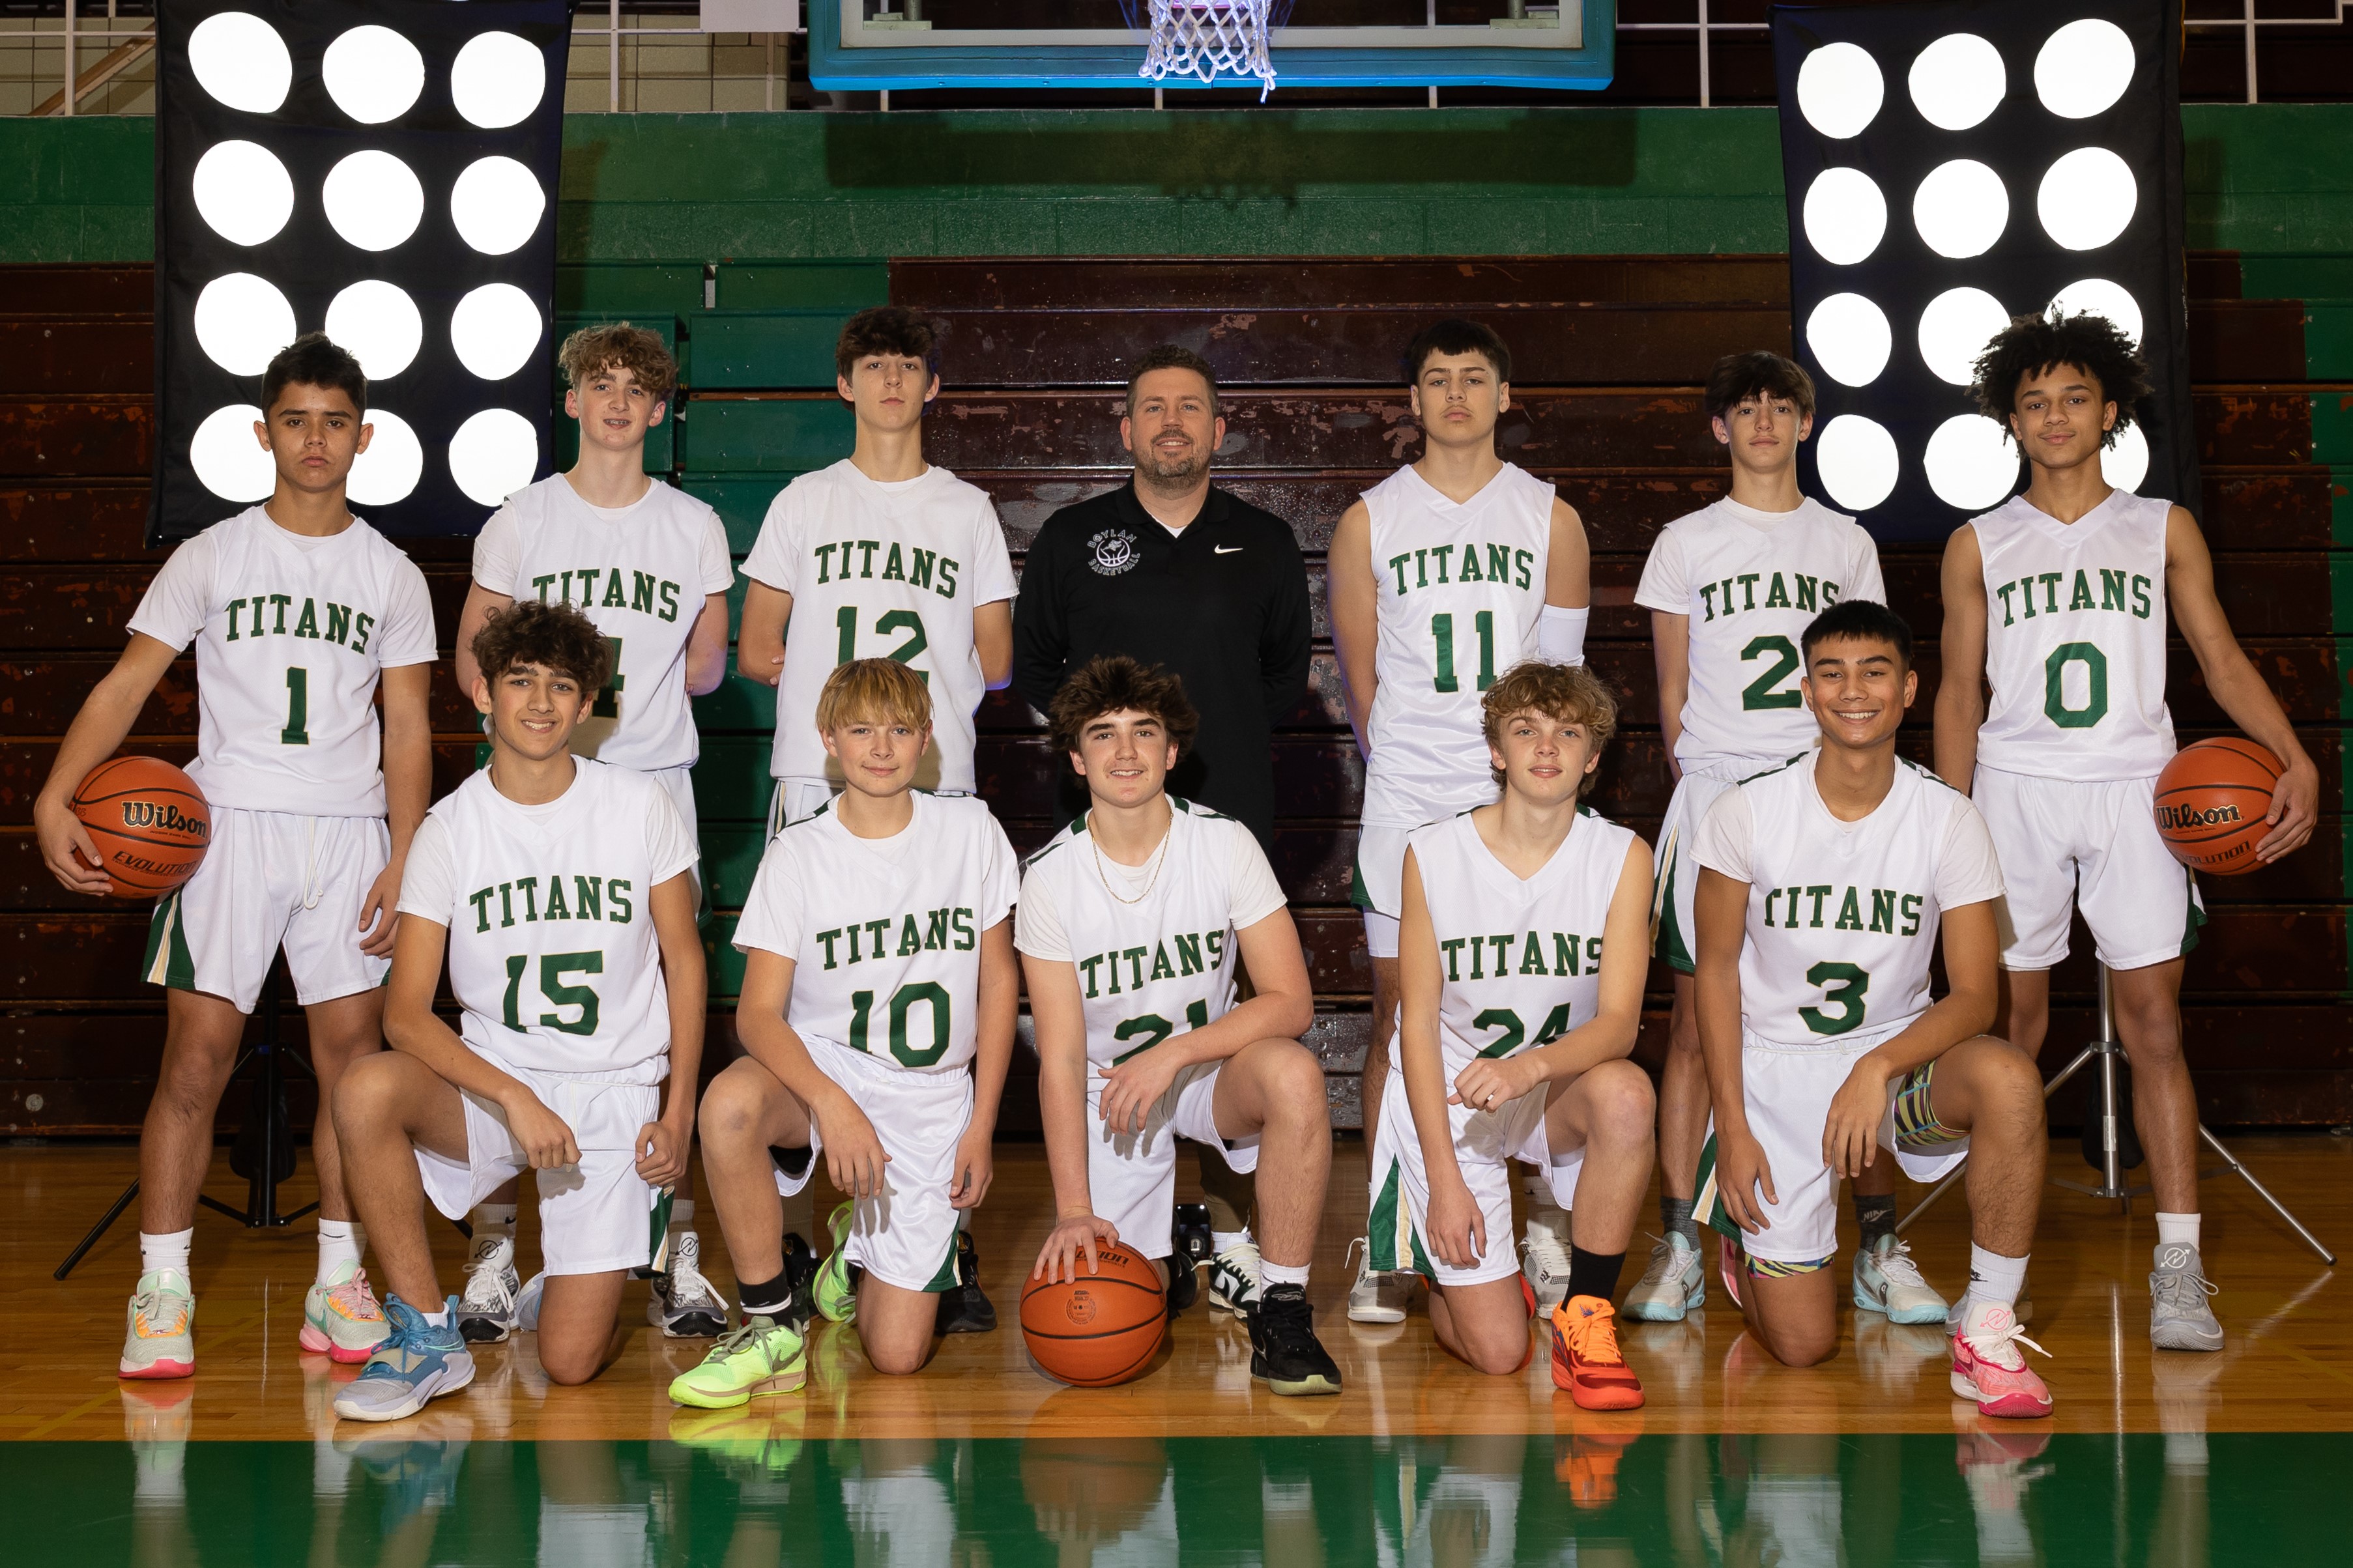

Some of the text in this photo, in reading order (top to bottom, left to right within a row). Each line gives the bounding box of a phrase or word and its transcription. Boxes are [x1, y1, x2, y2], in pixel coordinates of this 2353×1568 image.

[1087, 529, 1137, 548] BOYLAN
[1088, 553, 1140, 576] BASKETBALL
[532, 567, 680, 623] TITANS
[815, 540, 960, 600] TITANS
[1388, 542, 1535, 596] TITANS
[1699, 572, 1840, 623] TITANS
[1997, 568, 2152, 628] TITANS
[225, 593, 375, 655] TITANS
[837, 606, 930, 687] 12
[1431, 610, 1497, 693] 11
[281, 666, 310, 746] 1
[2043, 642, 2109, 729] 0
[122, 801, 207, 839] Wilson
[2156, 803, 2242, 831] Wilson
[469, 875, 633, 934] TITANS
[1764, 884, 1924, 937] TITANS
[815, 907, 975, 971] TITANS
[1079, 928, 1225, 999] TITANS
[1441, 930, 1604, 982] TITANS
[502, 949, 604, 1036] 15
[1798, 961, 1870, 1036] 3
[849, 981, 951, 1068] 10
